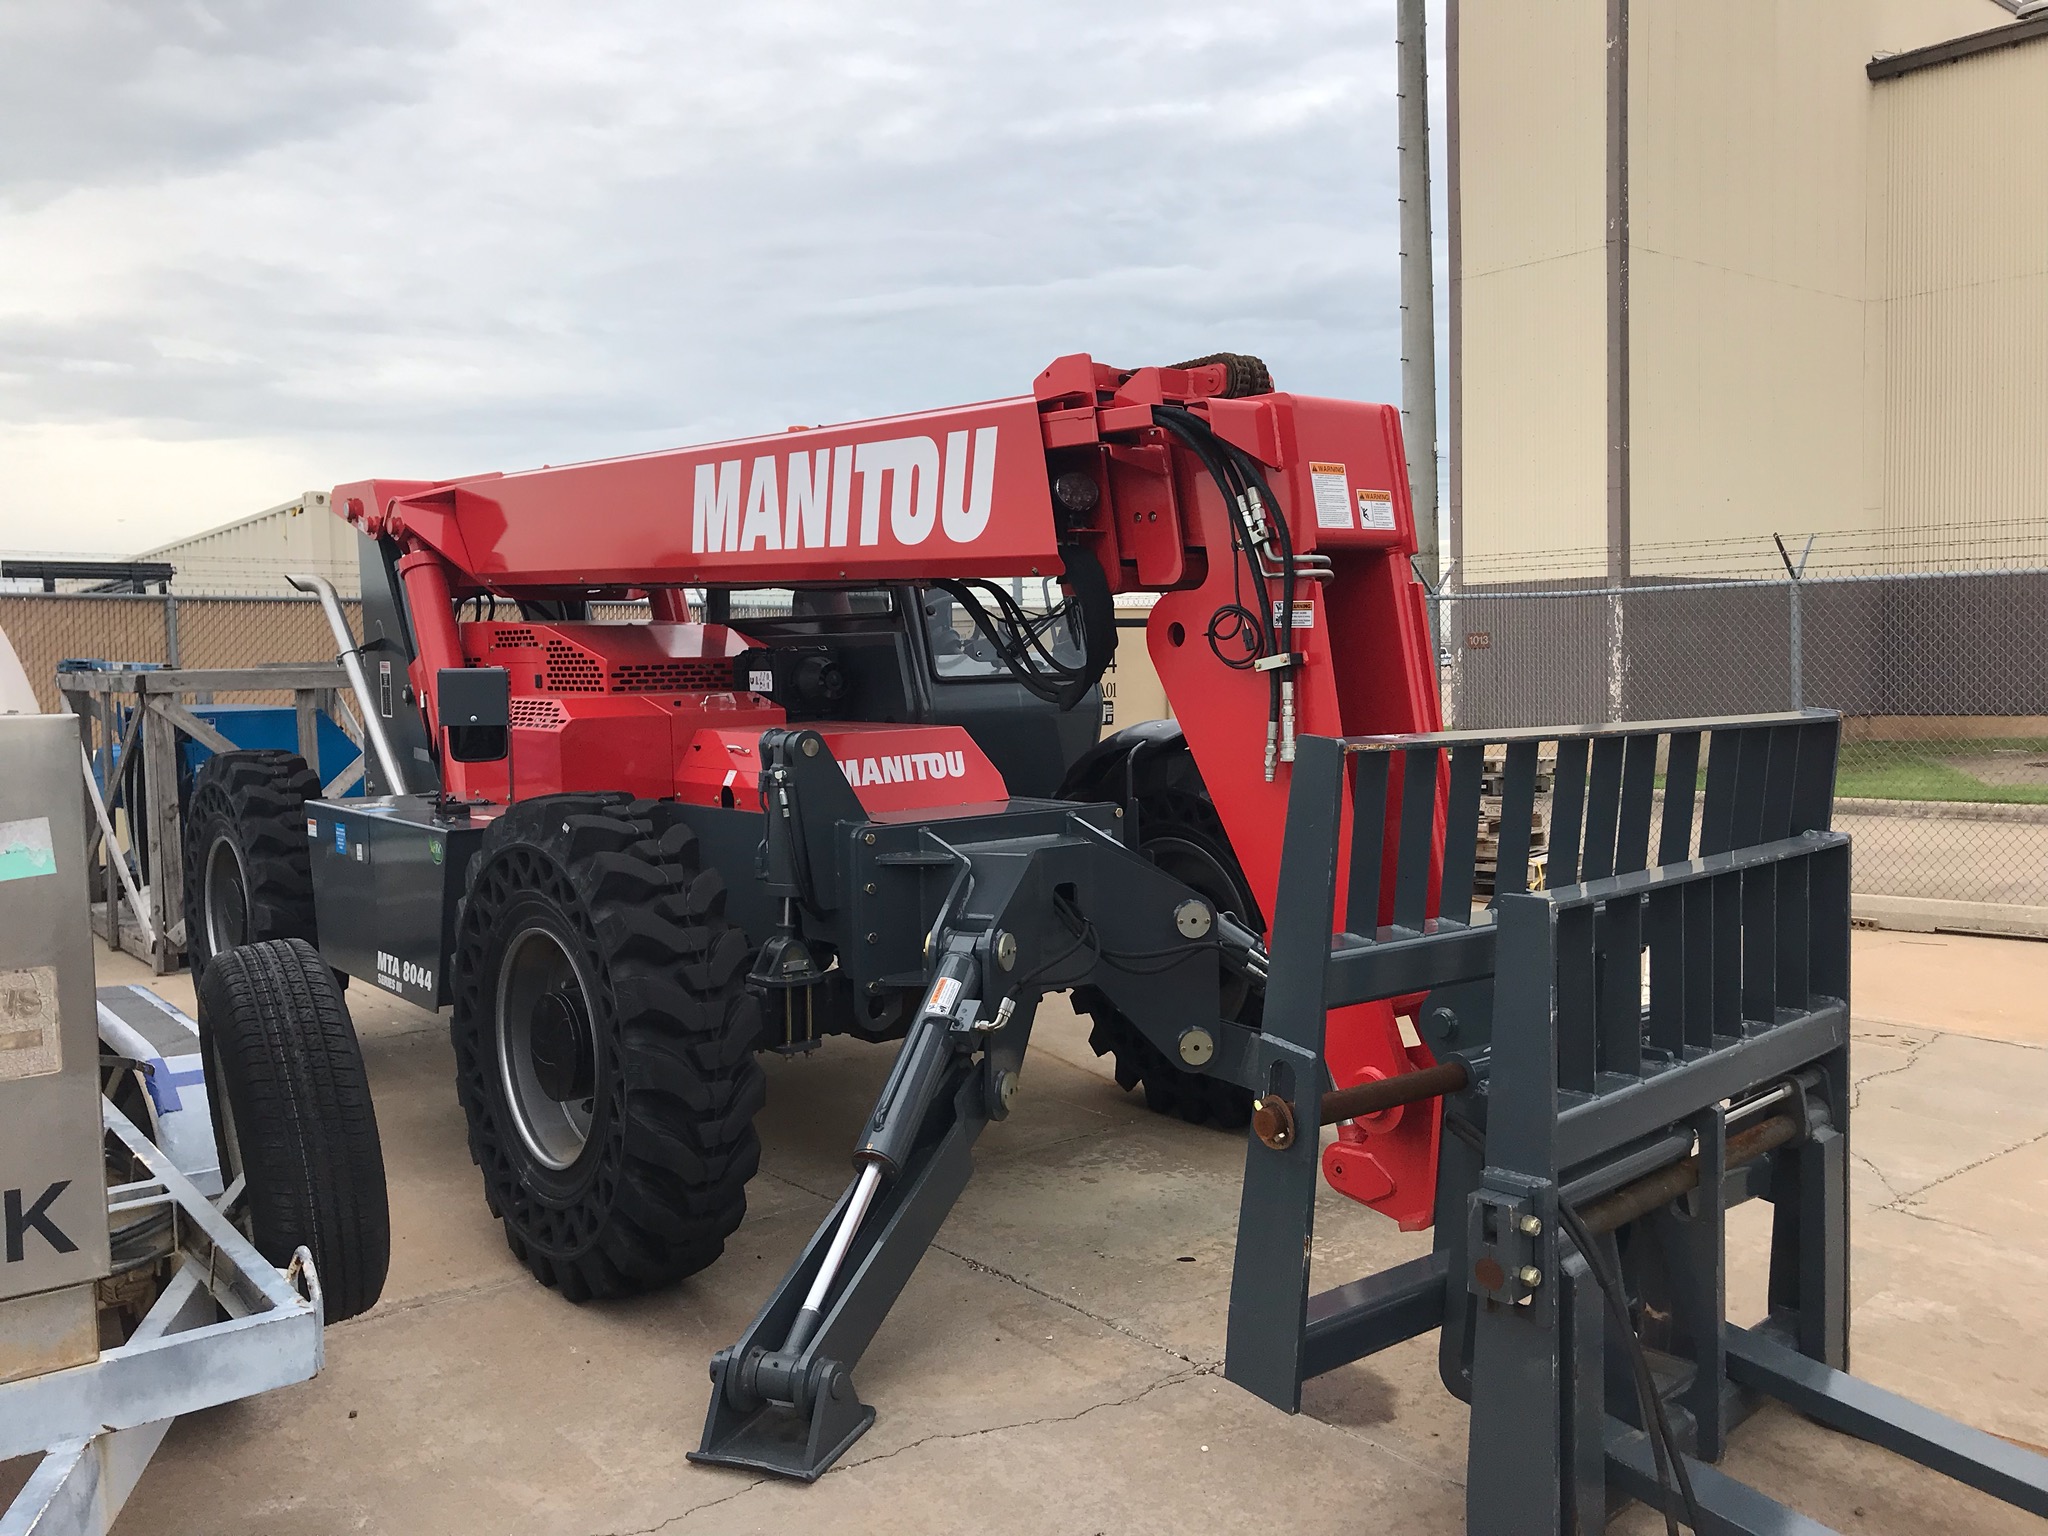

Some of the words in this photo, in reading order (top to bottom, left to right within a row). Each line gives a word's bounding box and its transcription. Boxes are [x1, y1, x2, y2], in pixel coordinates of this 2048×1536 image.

[1318, 466, 1345, 474] WARNING
[692, 426, 998, 553] MANITOU
[1365, 493, 1390, 501] WARNING
[1469, 635, 1489, 646] 1013
[837, 750, 966, 787] MANITOU
[377, 950, 400, 979] MTA
[402, 960, 432, 992] 8044
[377, 973, 396, 991] SERIES
[4, 1180, 79, 1263] K
